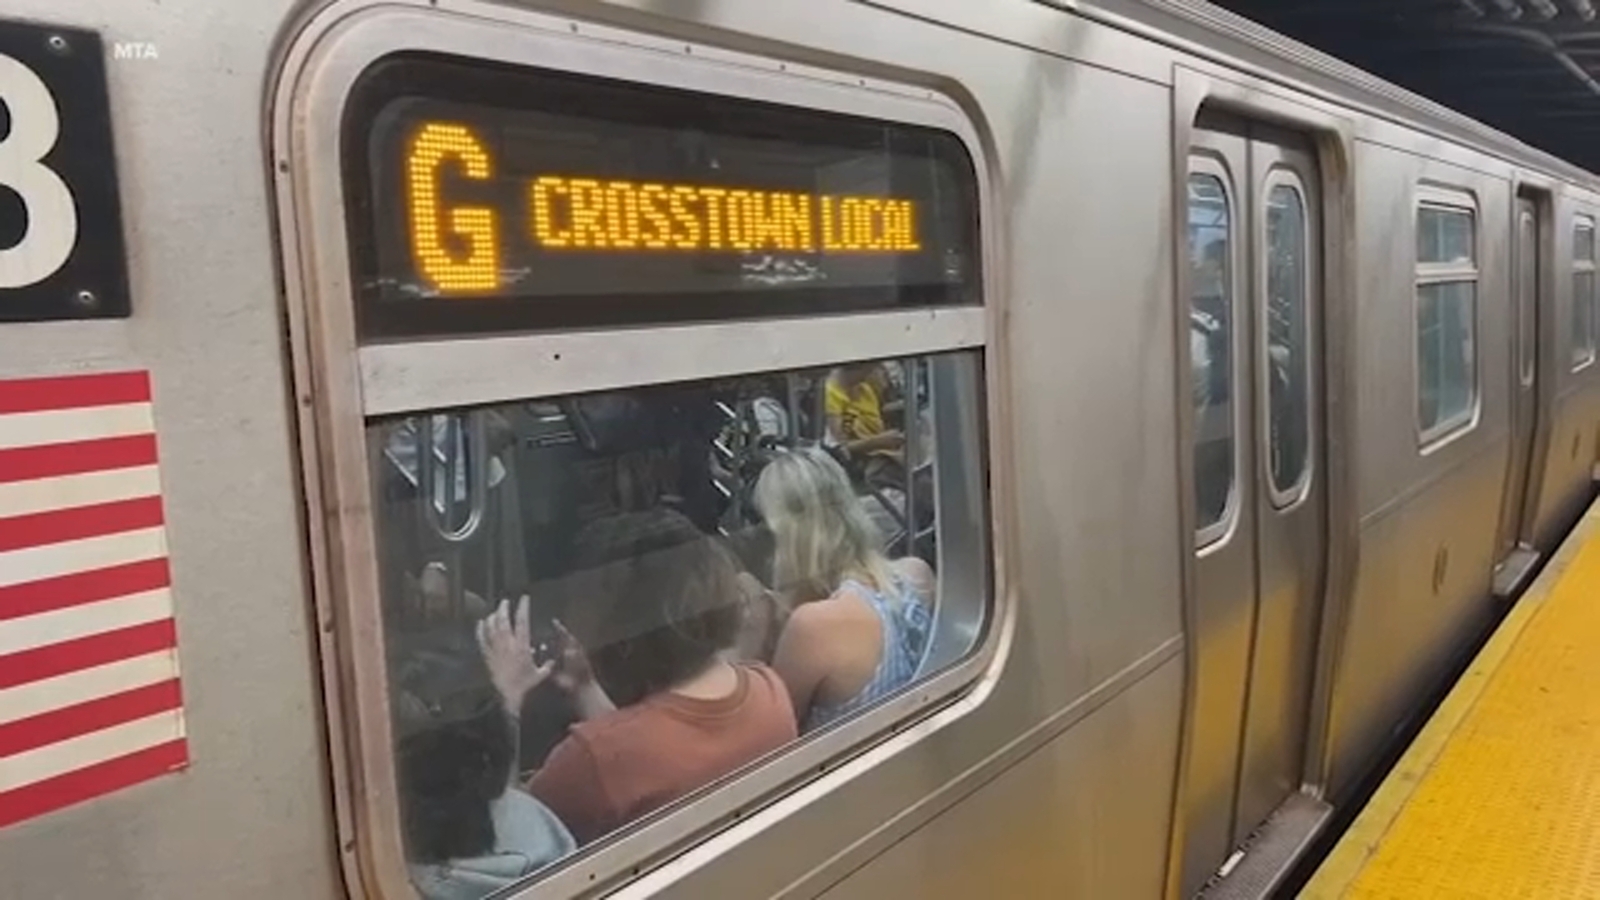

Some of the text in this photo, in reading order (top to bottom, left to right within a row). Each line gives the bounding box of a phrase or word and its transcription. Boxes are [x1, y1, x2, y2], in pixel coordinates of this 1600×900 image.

[408, 123, 920, 291] G CROSSTOWN LOCAL
